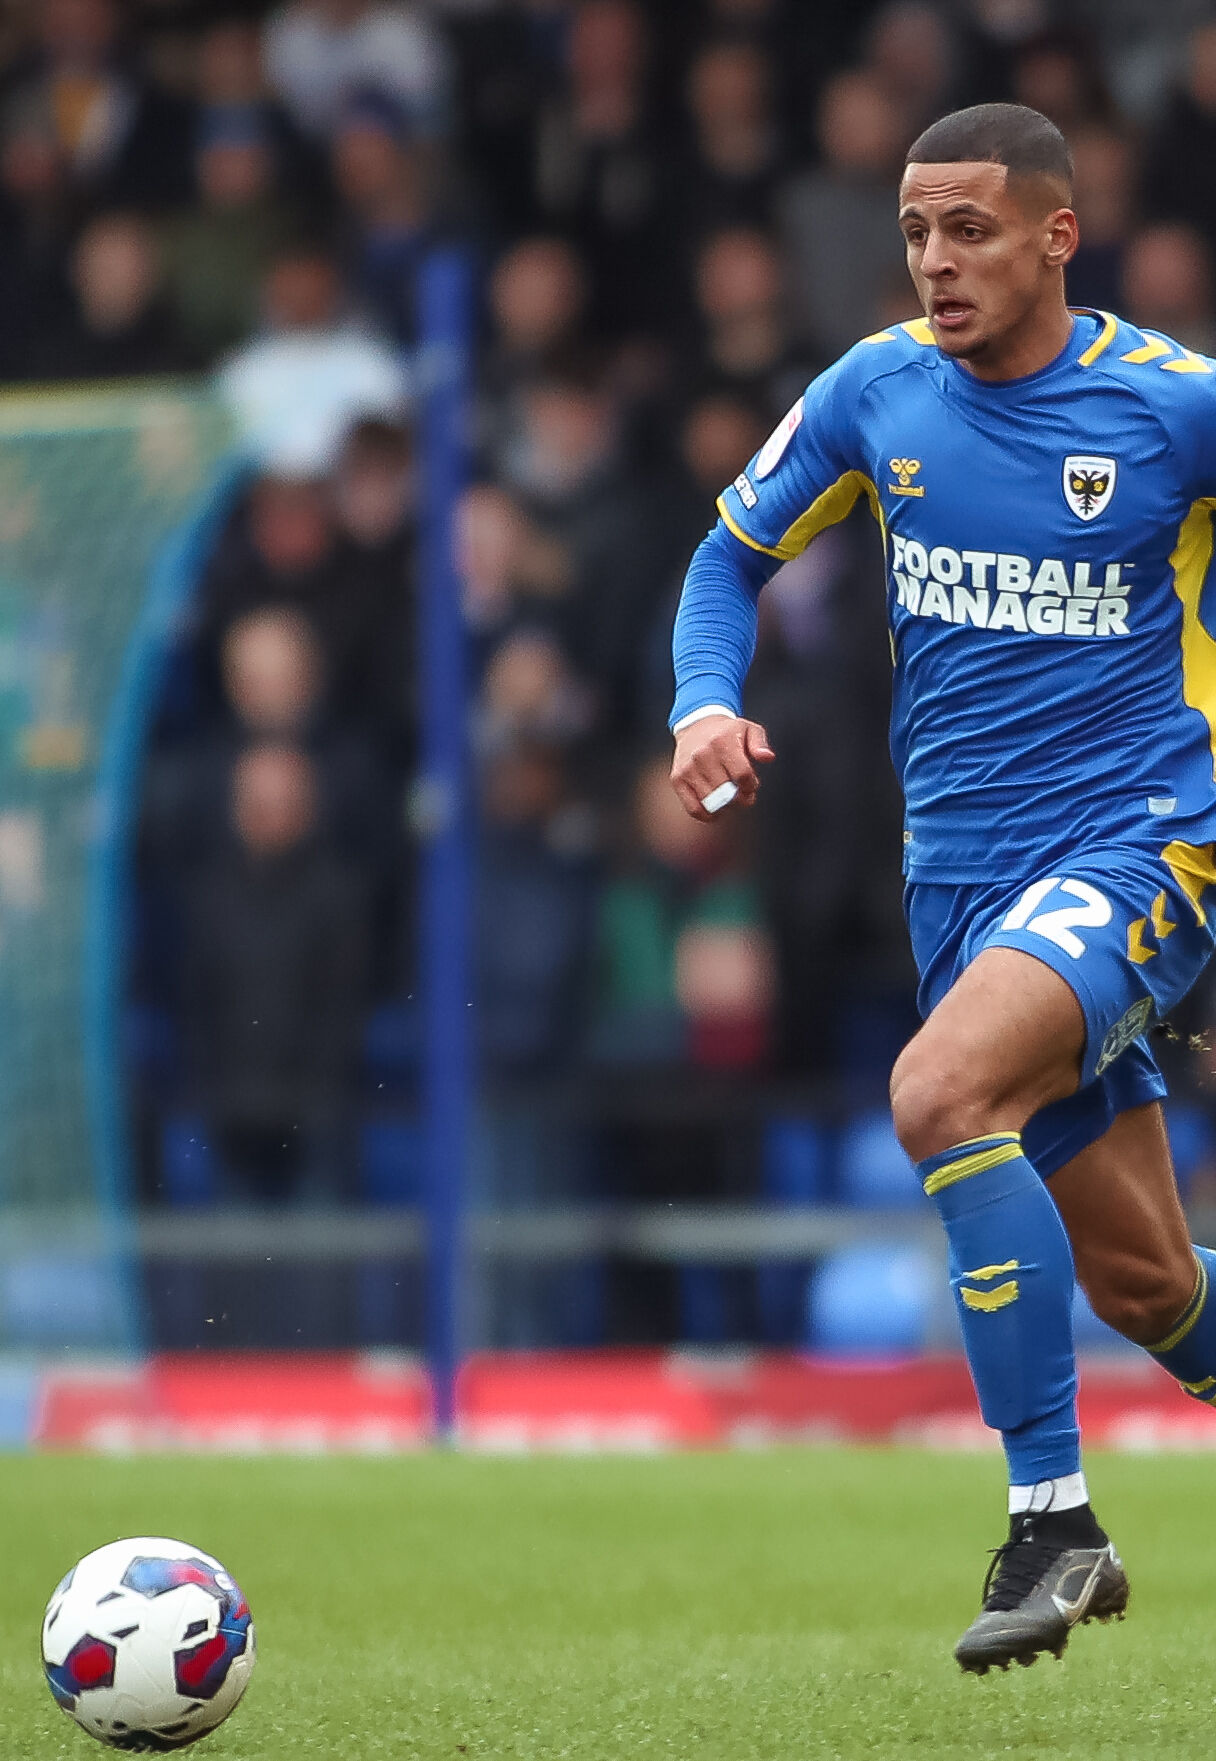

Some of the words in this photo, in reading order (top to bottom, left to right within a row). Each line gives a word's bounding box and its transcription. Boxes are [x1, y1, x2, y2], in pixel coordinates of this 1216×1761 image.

[892, 533, 1132, 598] FOOTBALL
[893, 571, 1131, 636] MANAGER
[1000, 877, 1112, 960] 12
